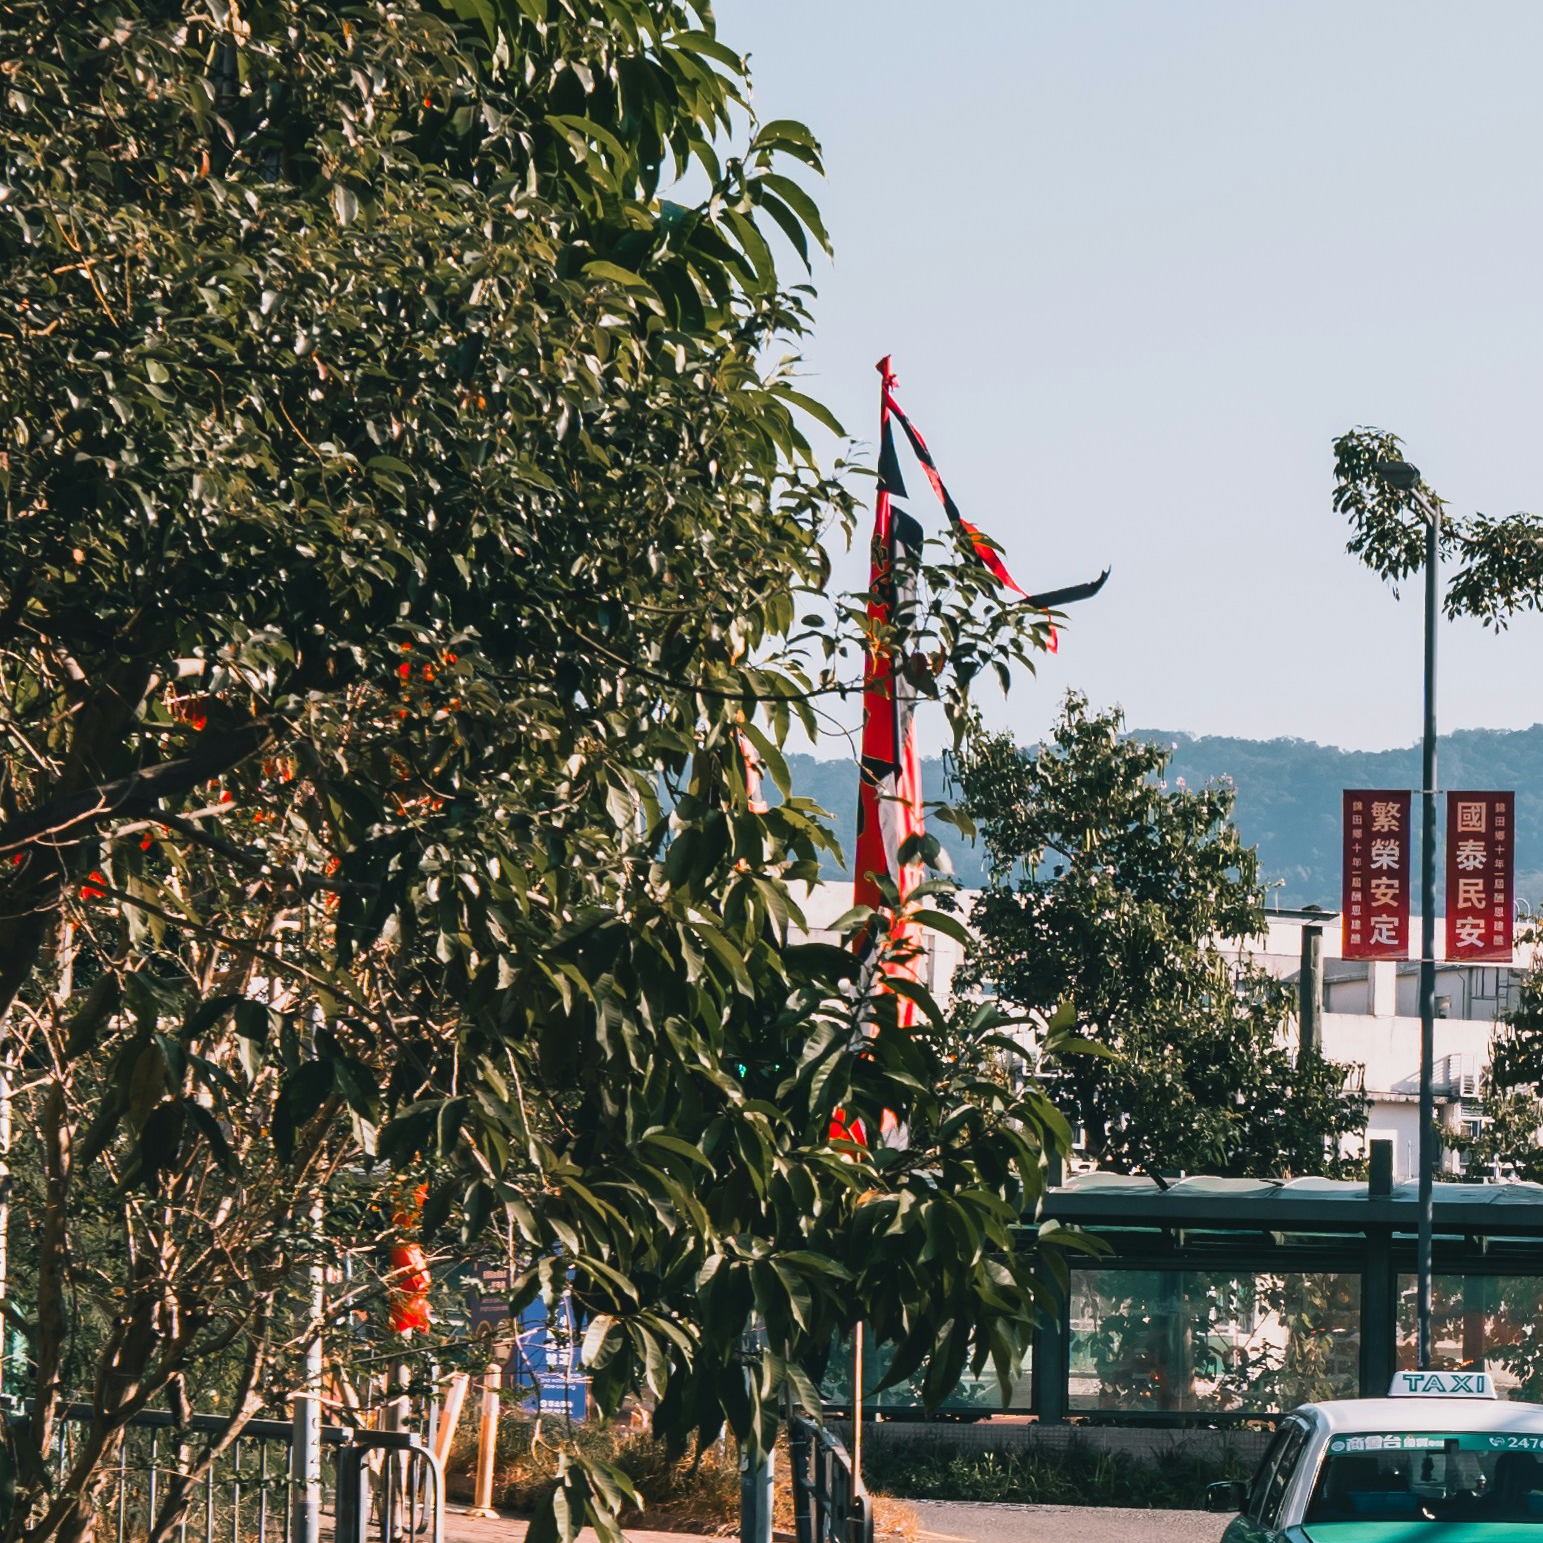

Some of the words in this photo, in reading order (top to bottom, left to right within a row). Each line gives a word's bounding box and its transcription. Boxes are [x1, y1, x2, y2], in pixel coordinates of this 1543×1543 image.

[1369, 801, 1401, 946] 繁榮安定
[1455, 801, 1487, 948] 國泰民安
[1403, 1374, 1485, 1393] TAXI
